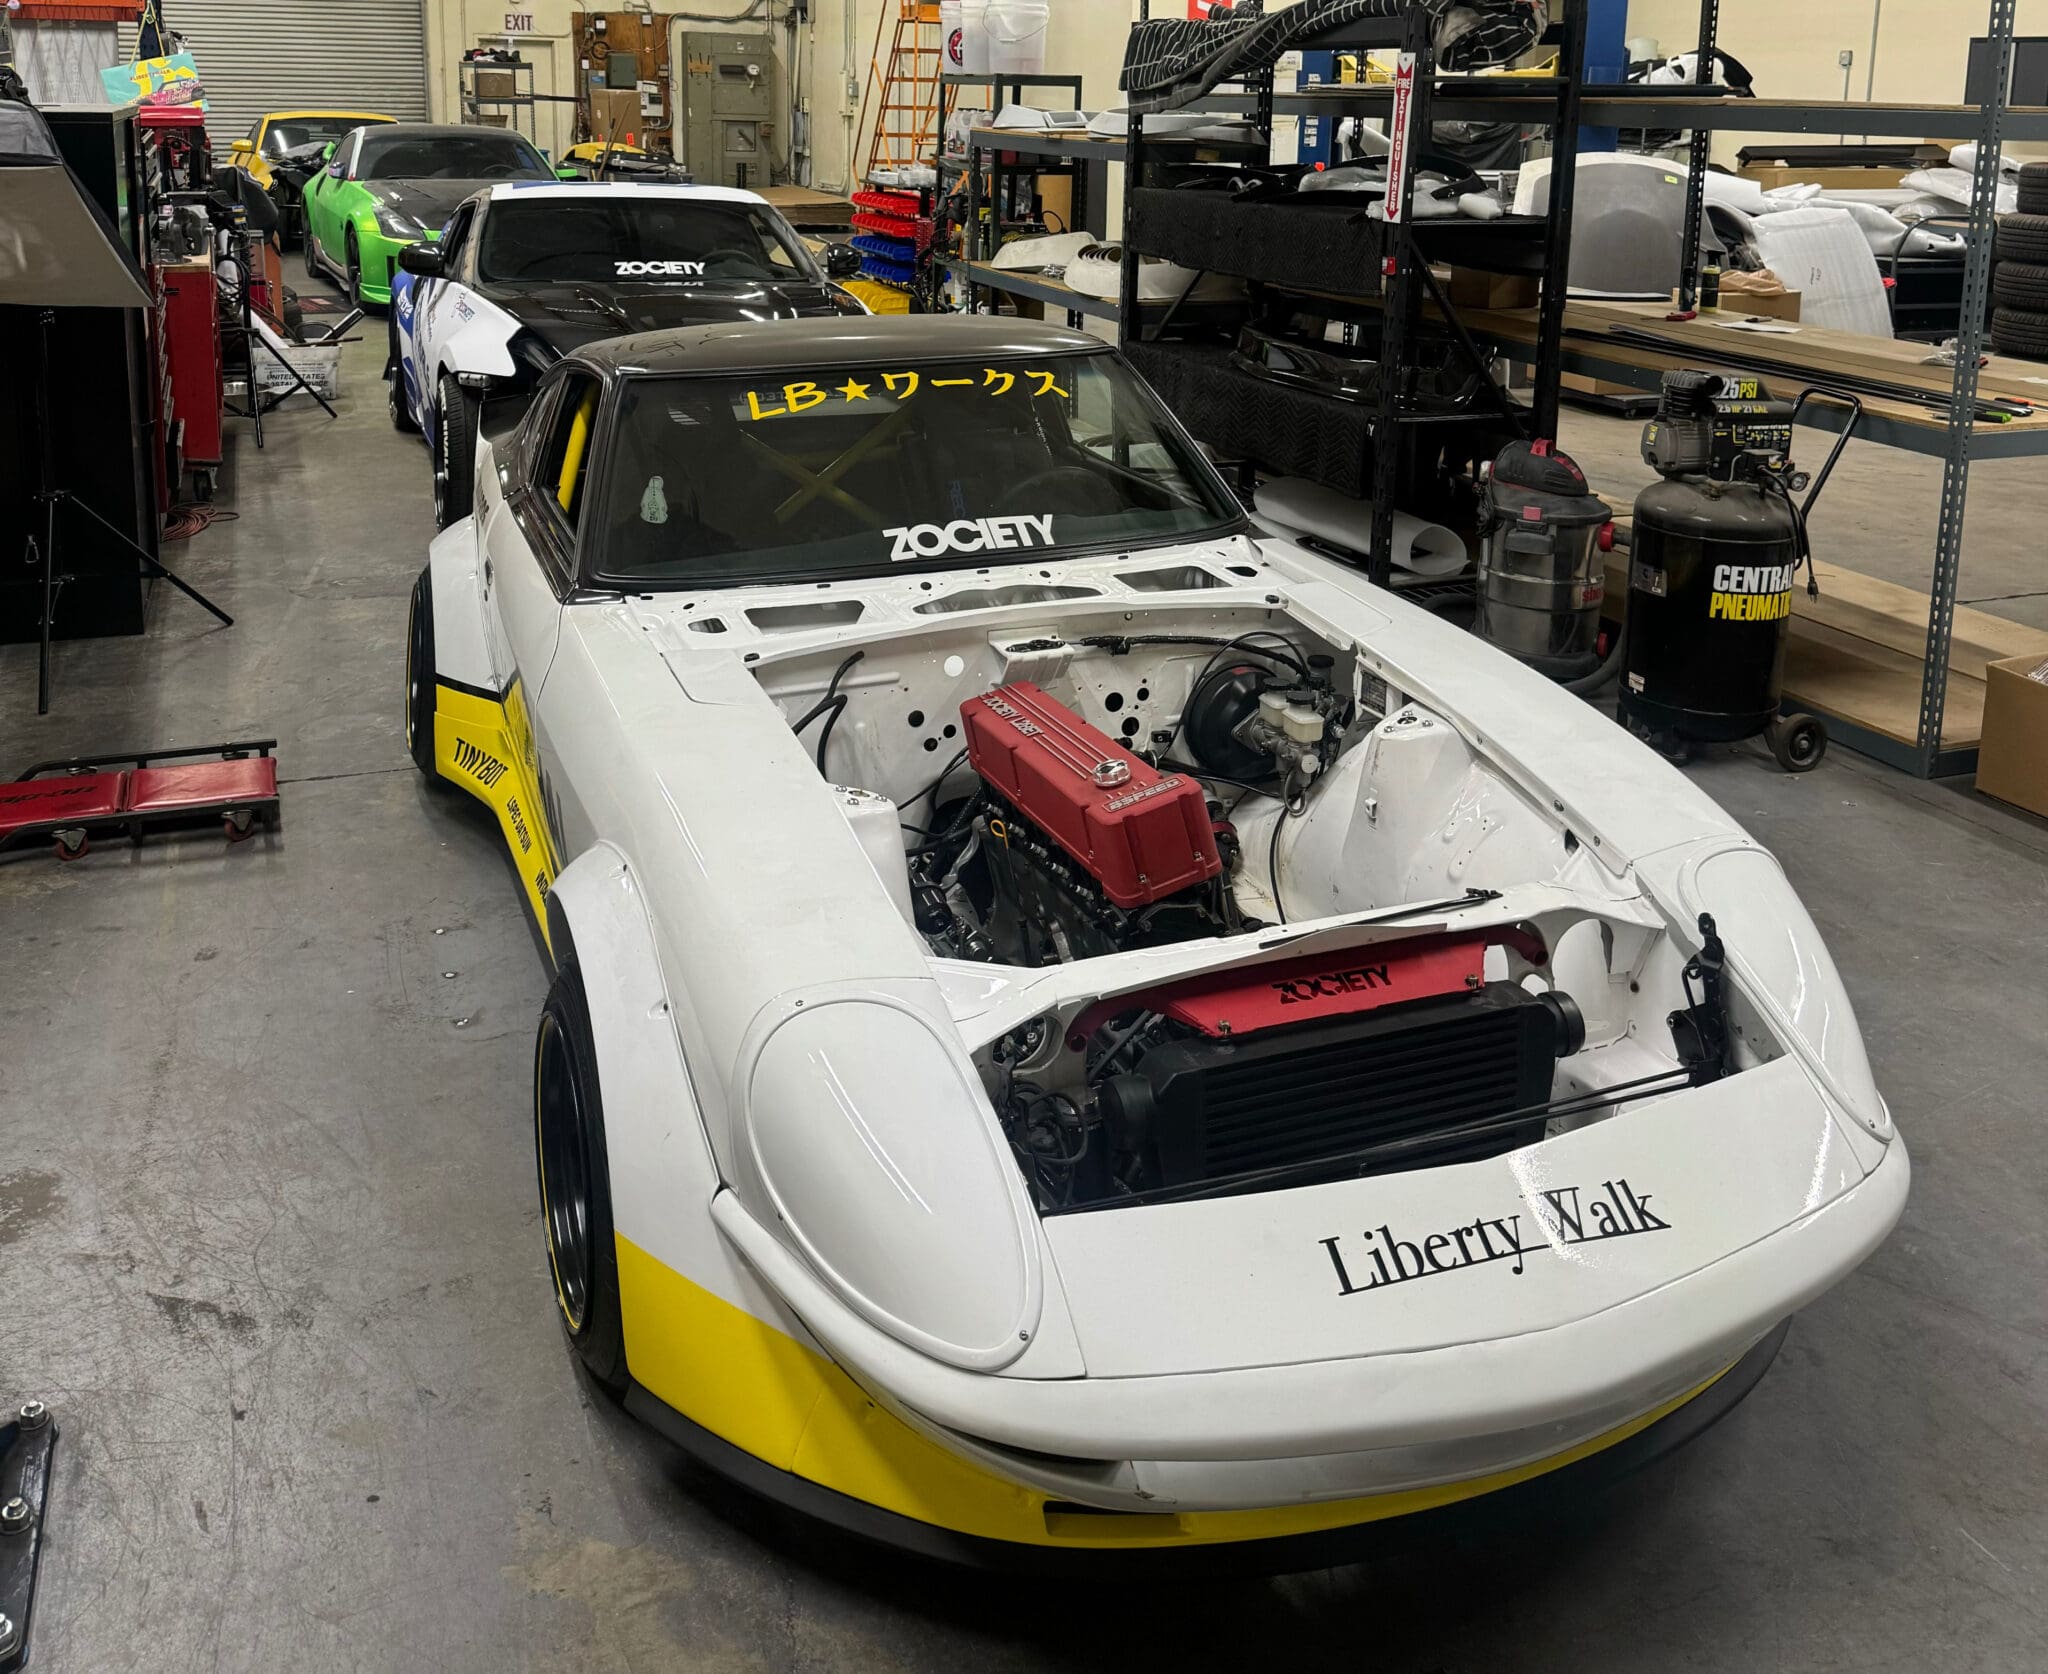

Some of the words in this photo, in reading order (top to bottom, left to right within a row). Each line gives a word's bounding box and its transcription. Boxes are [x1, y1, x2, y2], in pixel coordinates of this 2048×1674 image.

[505, 14, 533, 31] EXIT
[1397, 77, 1411, 89] FIRE
[1389, 89, 1407, 212] EXTINGUISHER
[614, 261, 705, 275] ZOCIETY
[1714, 377, 1740, 399] 25
[1739, 382, 1759, 399] PSI
[882, 514, 1055, 561] ZOCIETY
[1709, 589, 1792, 621] PNEUMATI
[453, 737, 509, 789] TINYBOT
[514, 818, 532, 855] DATSUN
[1271, 964, 1393, 1005] ZOCIETY
[1318, 1215, 1523, 1296] Liberty
[1519, 1178, 1672, 1244] Walk
